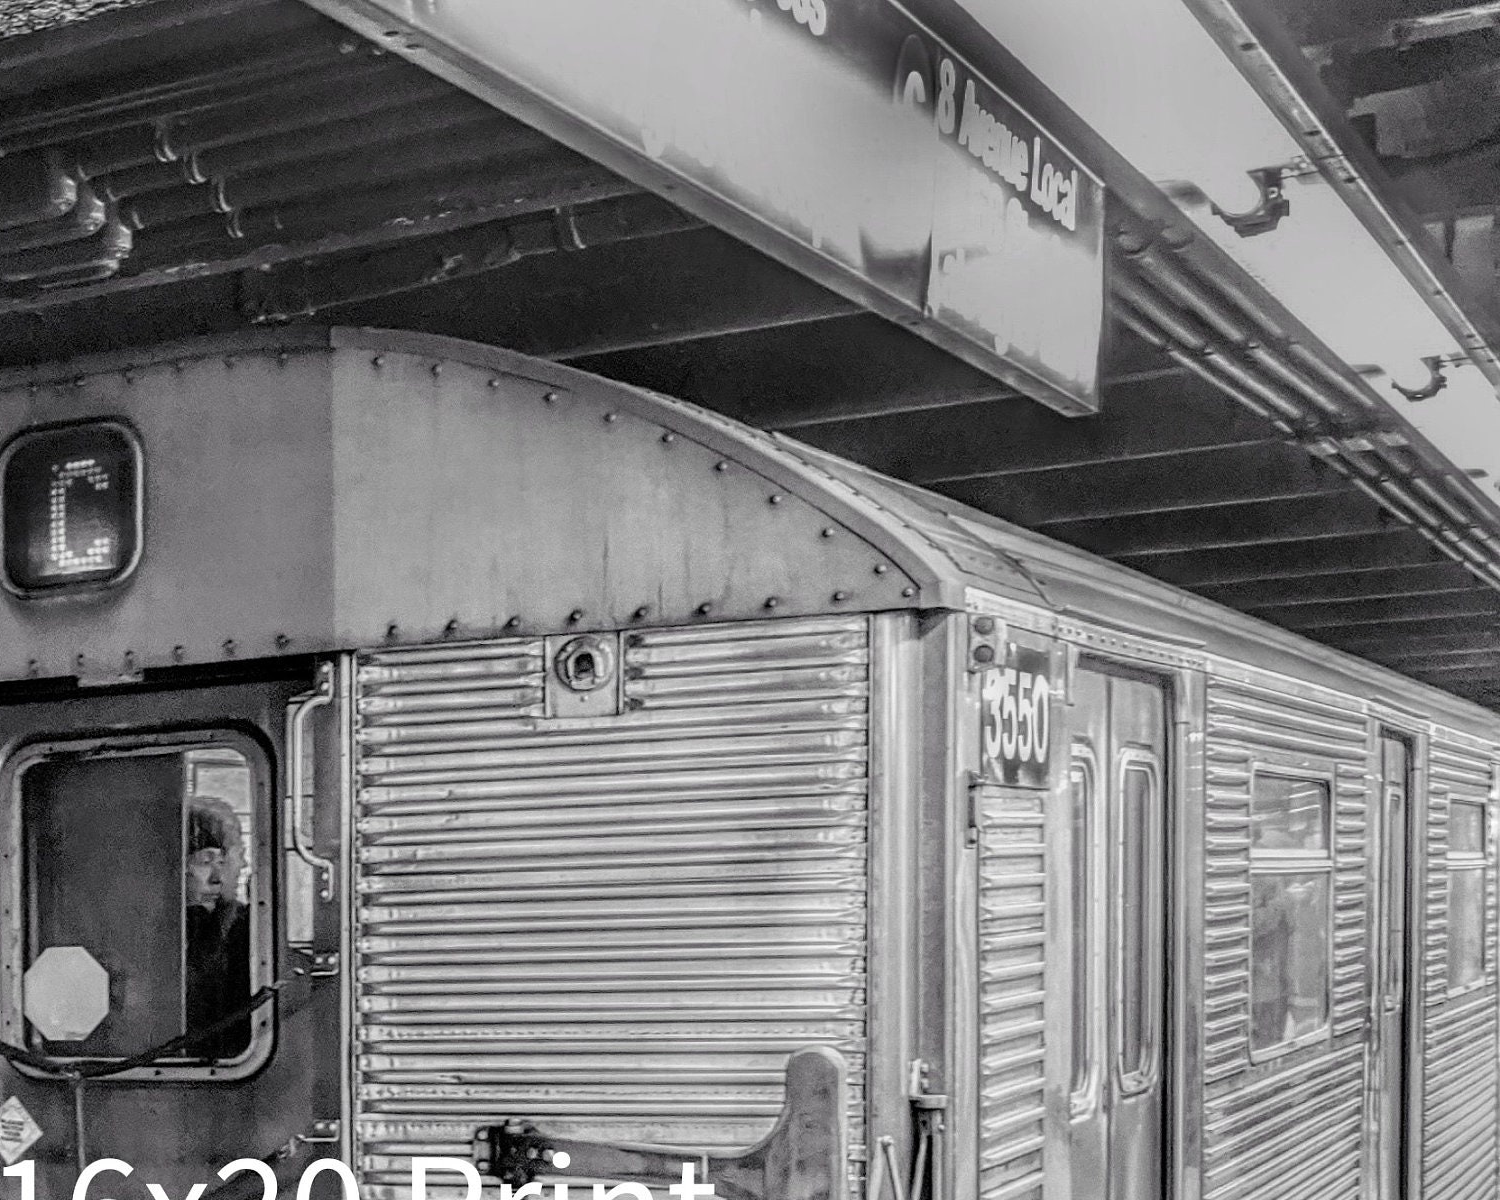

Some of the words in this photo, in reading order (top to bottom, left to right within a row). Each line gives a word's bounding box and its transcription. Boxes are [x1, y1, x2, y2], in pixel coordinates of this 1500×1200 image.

[937, 58, 956, 134] 8
[1030, 136, 1078, 231] Local
[50, 459, 110, 568] C
[983, 668, 1049, 763] 3550
